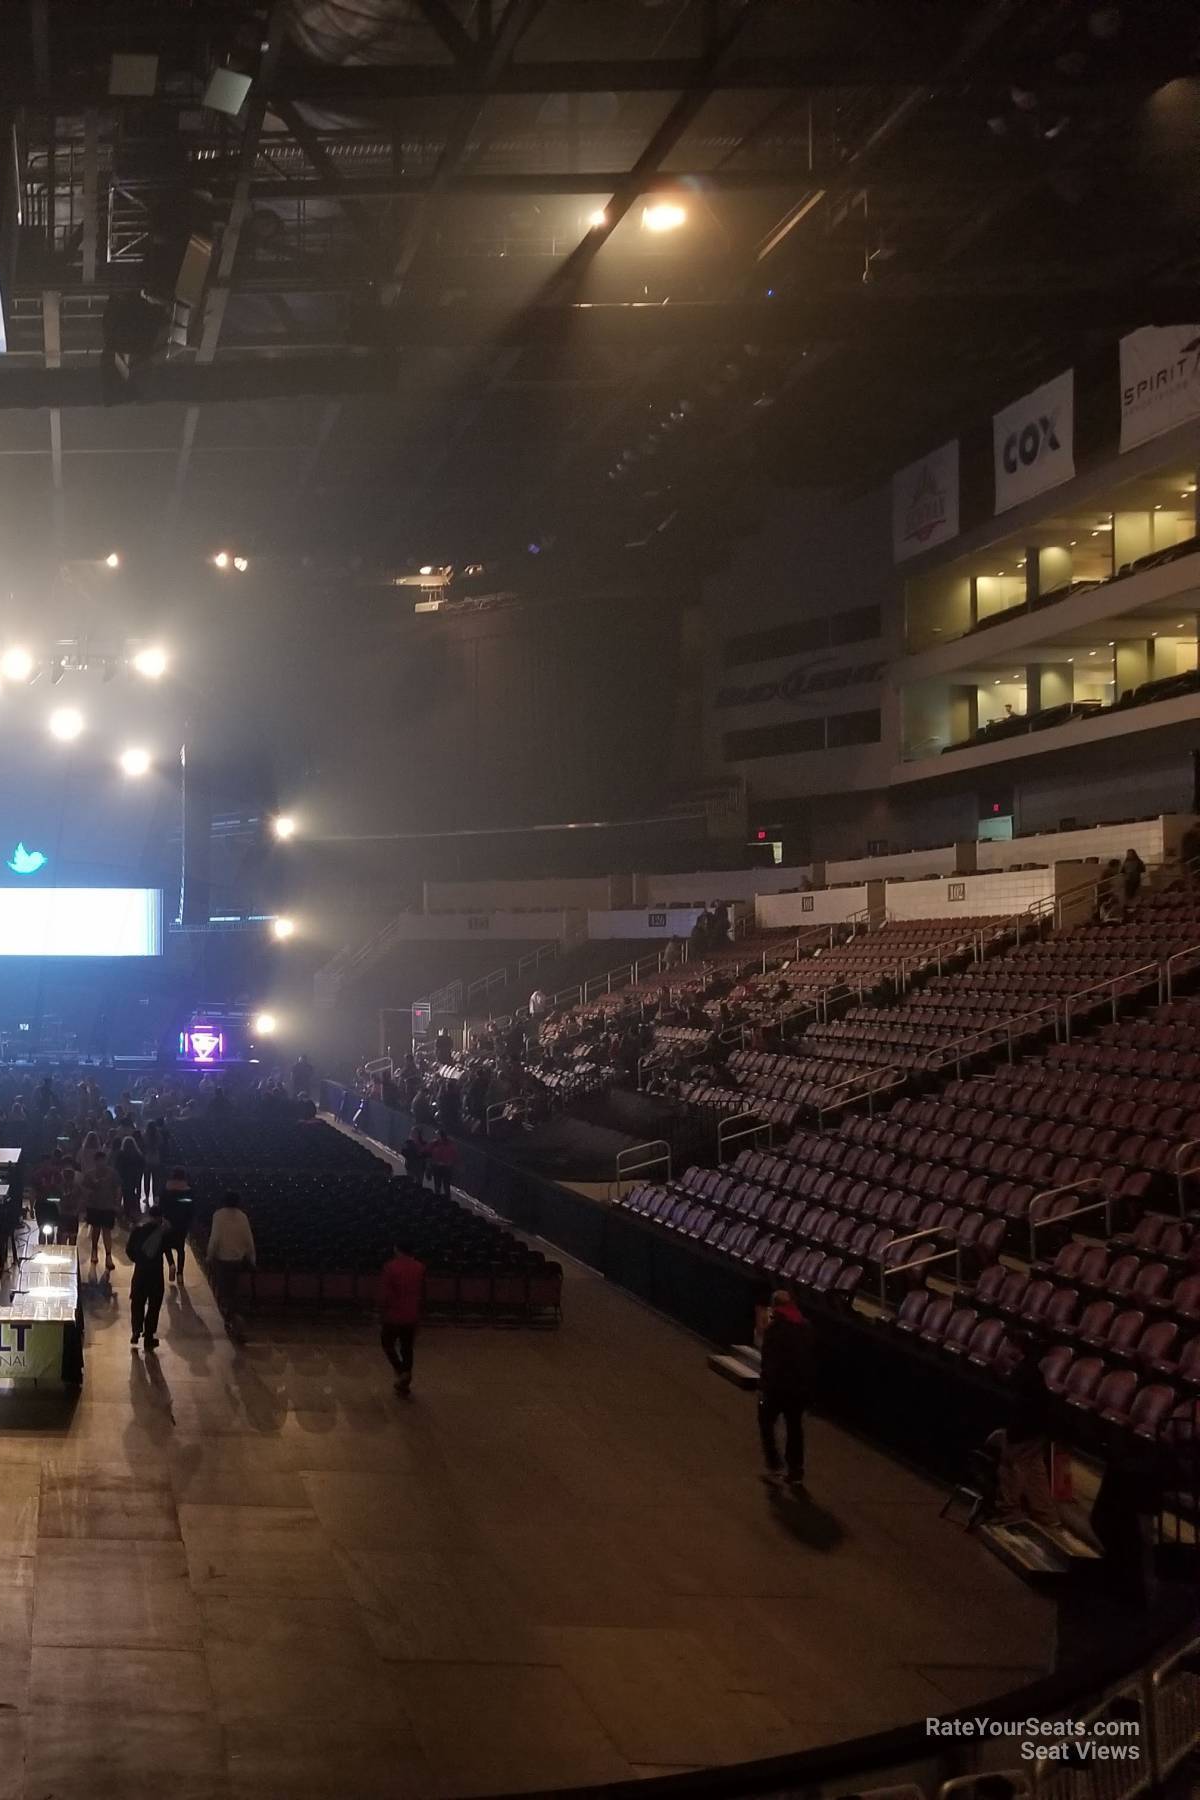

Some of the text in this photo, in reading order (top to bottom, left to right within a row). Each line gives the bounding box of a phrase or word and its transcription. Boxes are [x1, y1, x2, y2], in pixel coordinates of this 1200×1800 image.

[1123, 358, 1188, 407] SPIRIT
[1003, 411, 1061, 474] COX
[950, 885, 964, 900] 102
